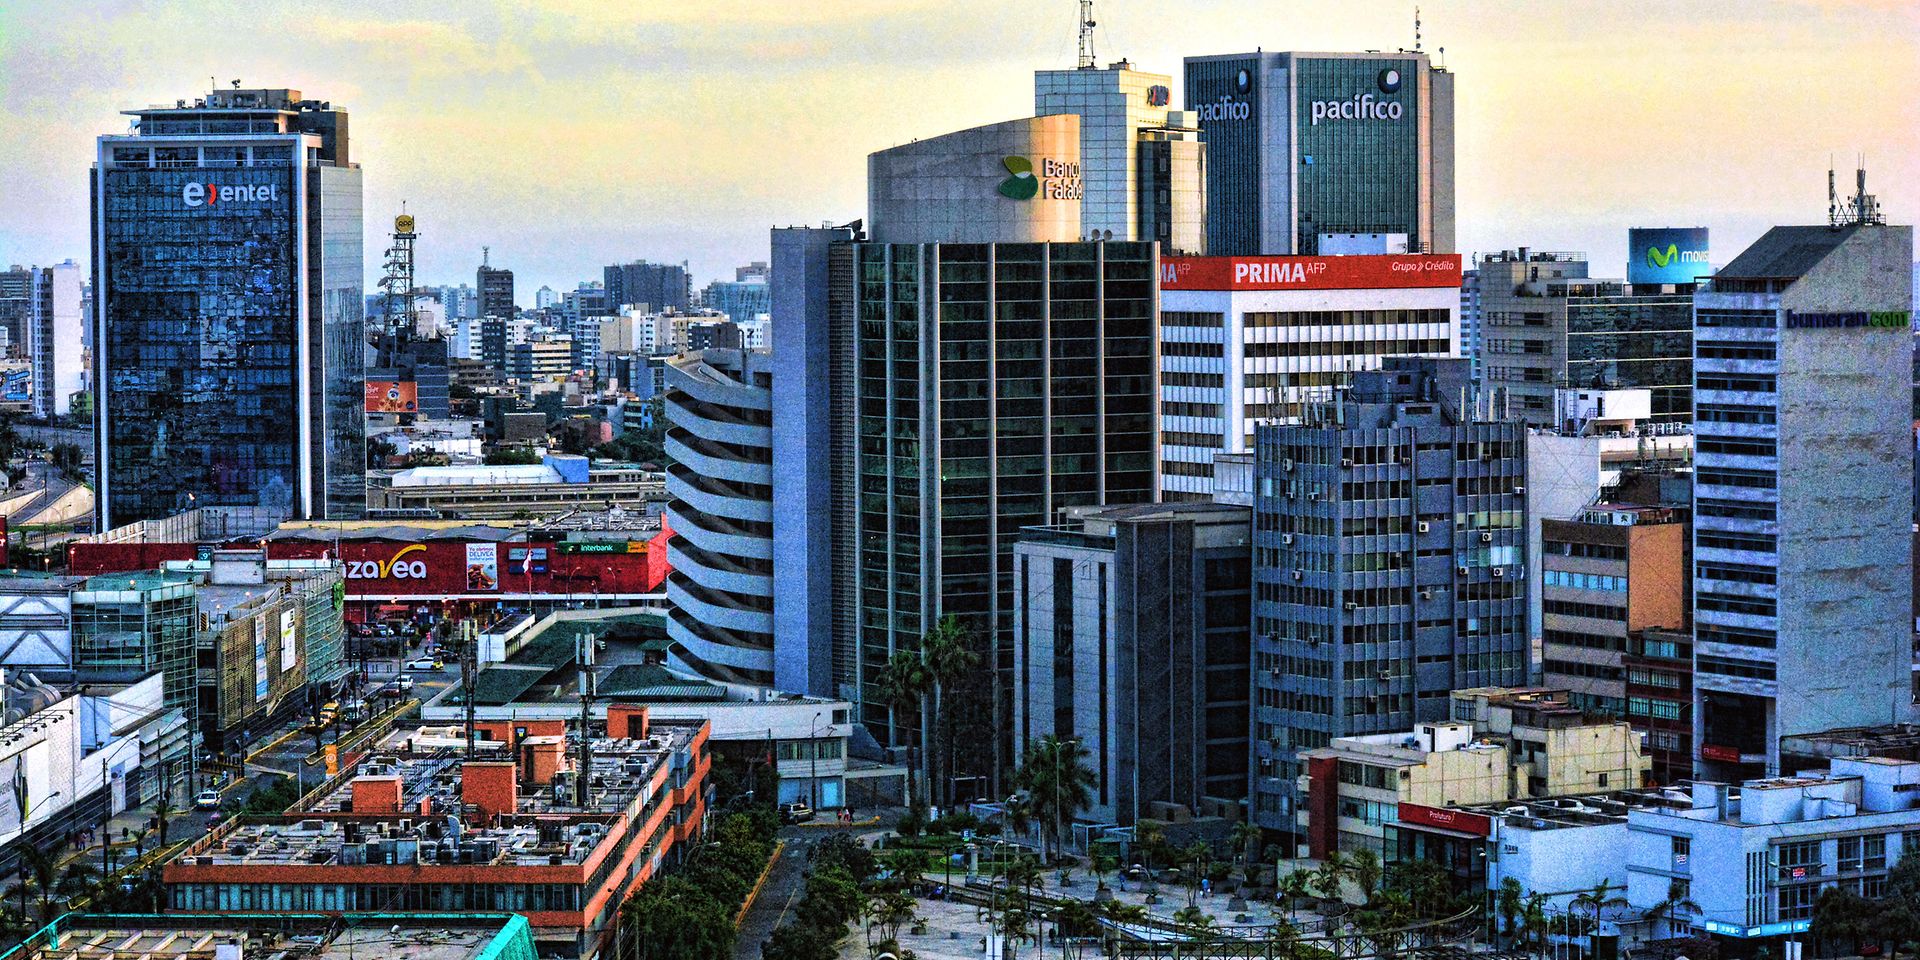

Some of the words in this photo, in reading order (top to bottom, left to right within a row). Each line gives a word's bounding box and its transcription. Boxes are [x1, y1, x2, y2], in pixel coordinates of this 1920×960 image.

[1311, 93, 1402, 126] pacifico
[220, 184, 278, 201] entel
[1177, 263, 1191, 275] AFP
[1235, 263, 1306, 283] PRIMA
[1307, 262, 1327, 274] AFP
[1391, 261, 1417, 272] Grupo
[1425, 260, 1455, 271] Crédito
[581, 544, 613, 552] Interbank
